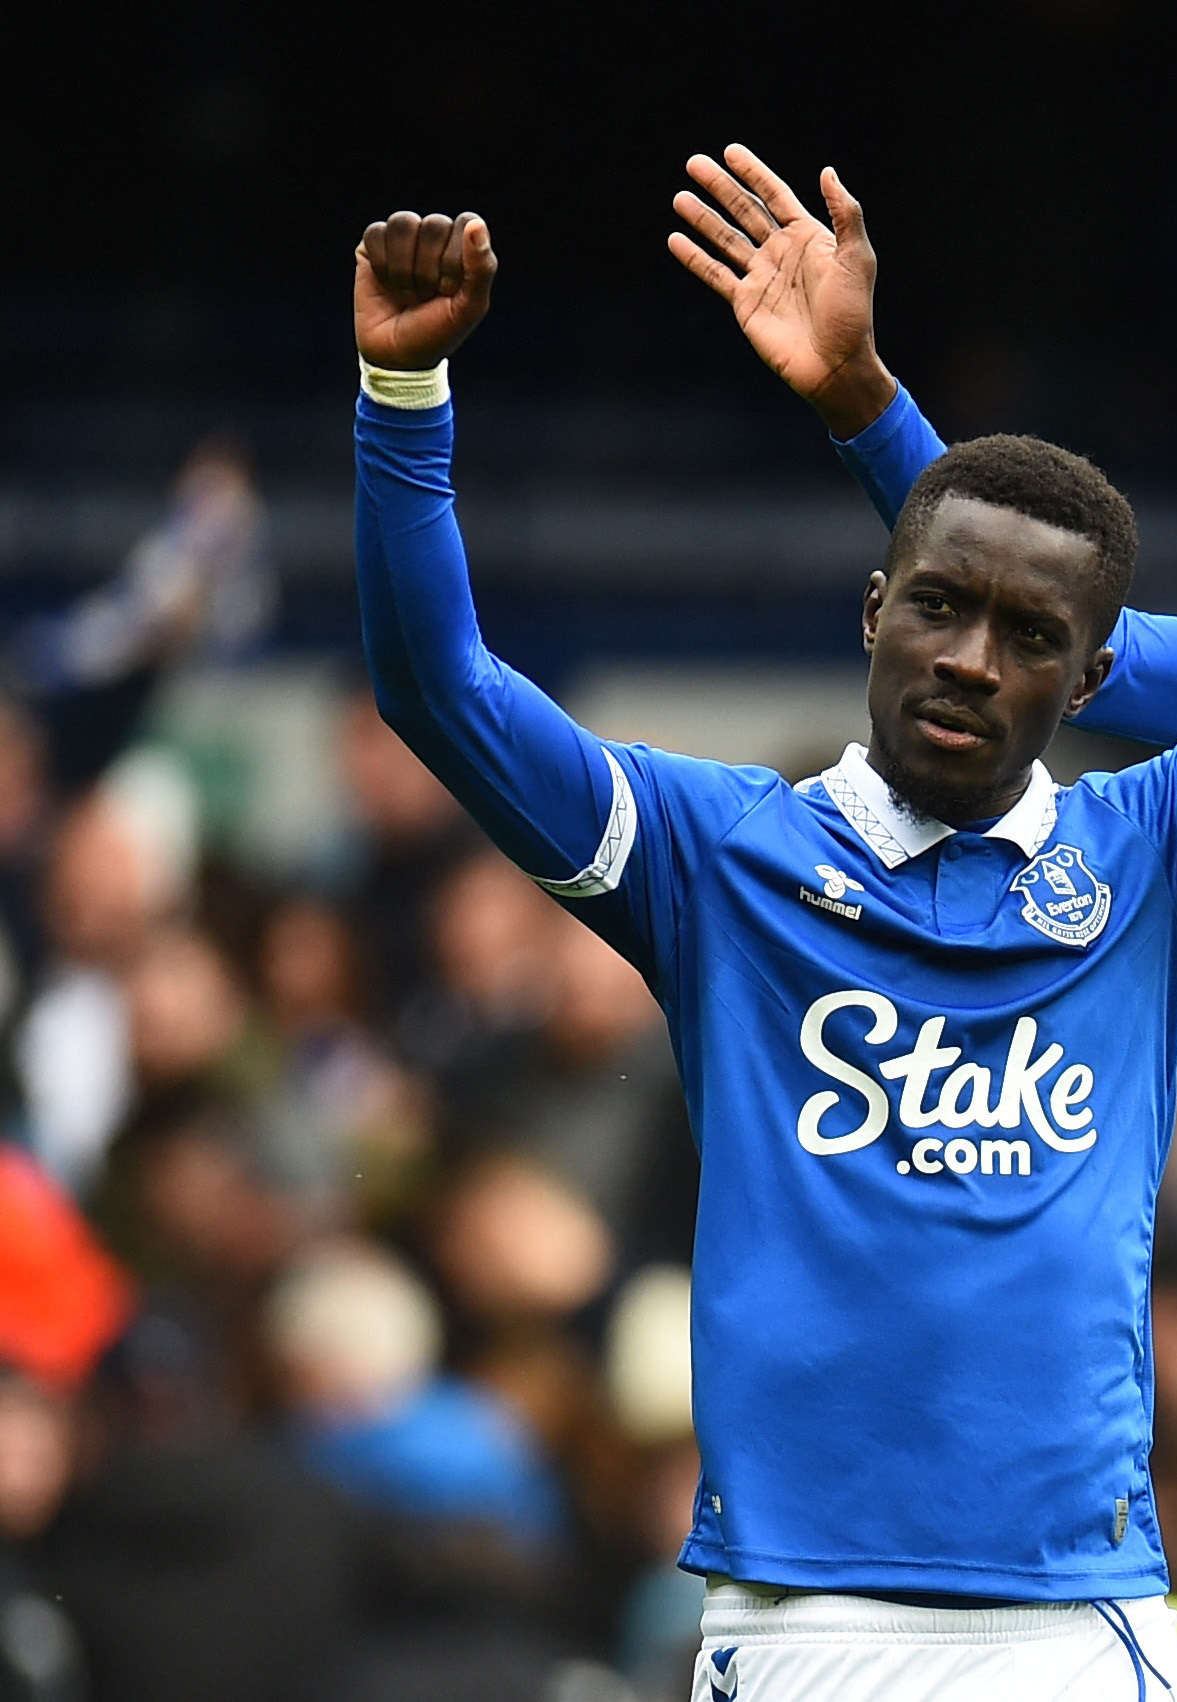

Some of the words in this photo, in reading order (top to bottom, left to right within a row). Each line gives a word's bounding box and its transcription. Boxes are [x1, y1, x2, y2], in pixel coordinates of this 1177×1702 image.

[800, 886, 862, 920] hummel
[1045, 894, 1093, 916] Everton
[797, 990, 1097, 1156] Stake
[896, 1138, 1031, 1176] .com
